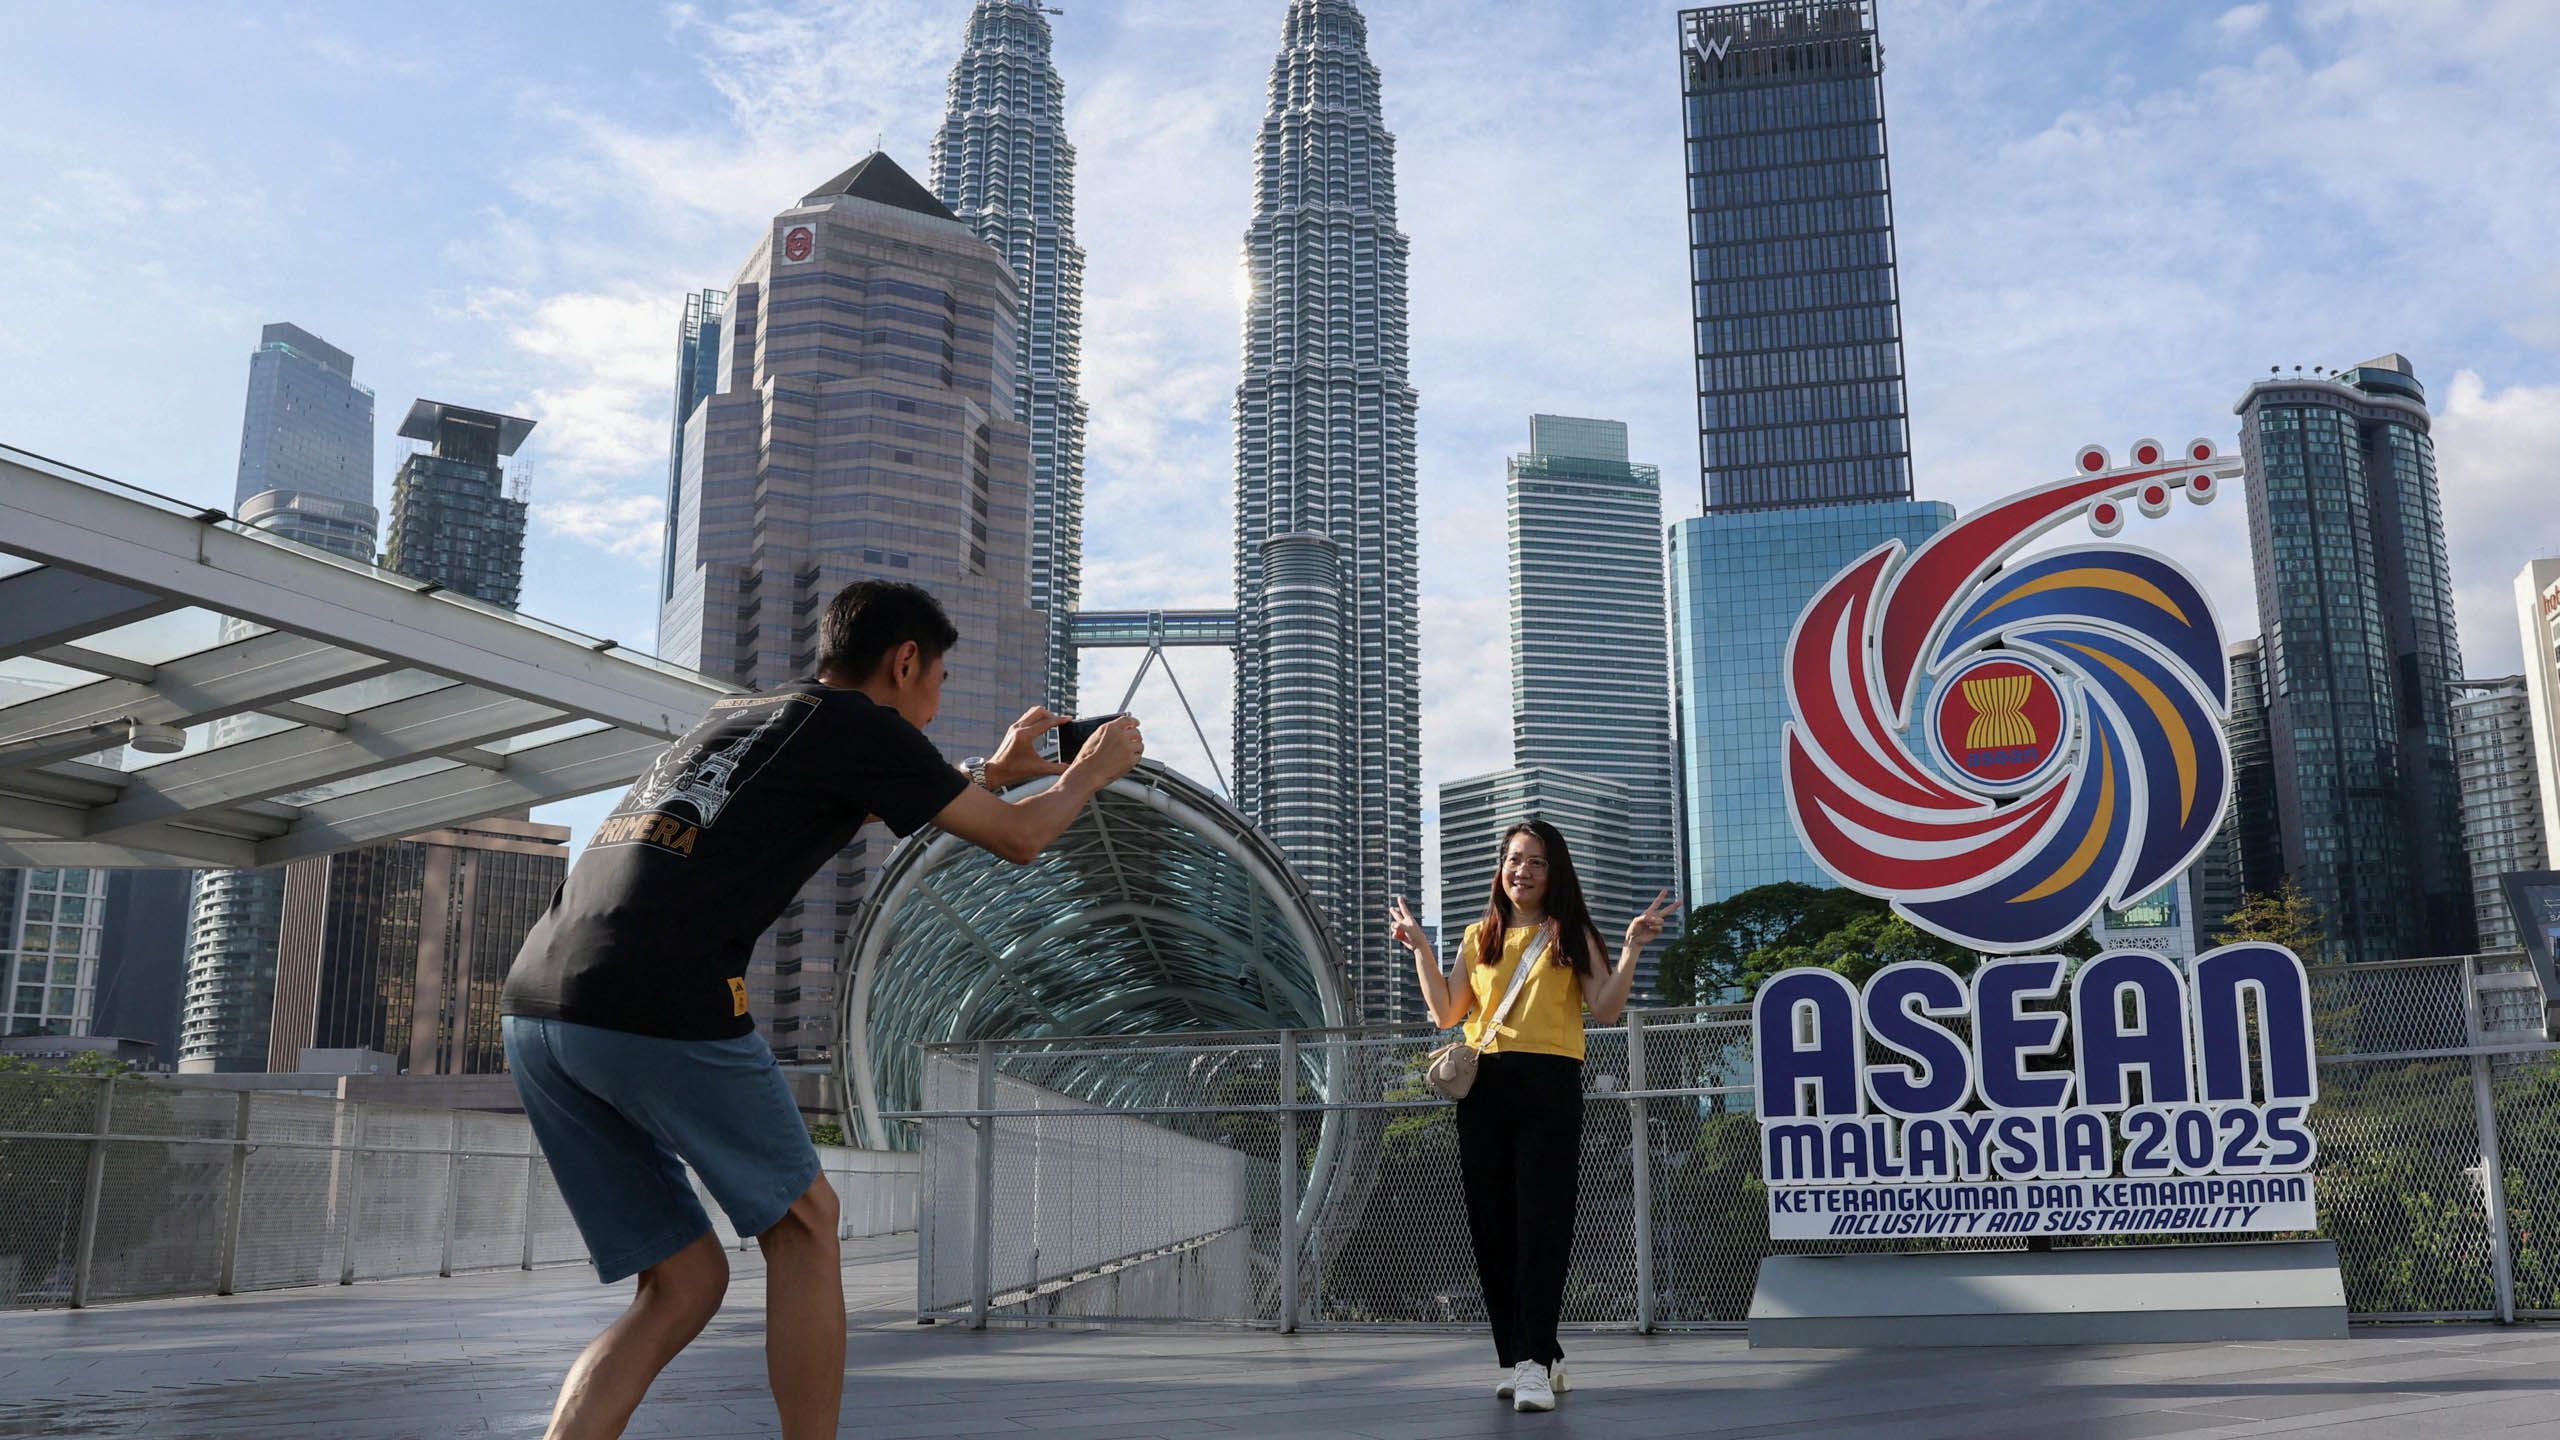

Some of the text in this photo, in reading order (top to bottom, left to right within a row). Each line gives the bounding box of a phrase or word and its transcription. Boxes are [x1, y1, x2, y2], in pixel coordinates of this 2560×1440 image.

[1966, 747, 2039, 767] asean
[590, 814, 698, 854] PRIMERA
[1758, 946, 2312, 1118] ASEAN
[1768, 1105, 2311, 1181] MALAYSIA 2025
[1774, 1177, 2306, 1213] KETERANGKUMAN DAN KEMAMPANAN
[1829, 1206, 2261, 1235] INCLUSIVITY AND SUSTAINABILITY
